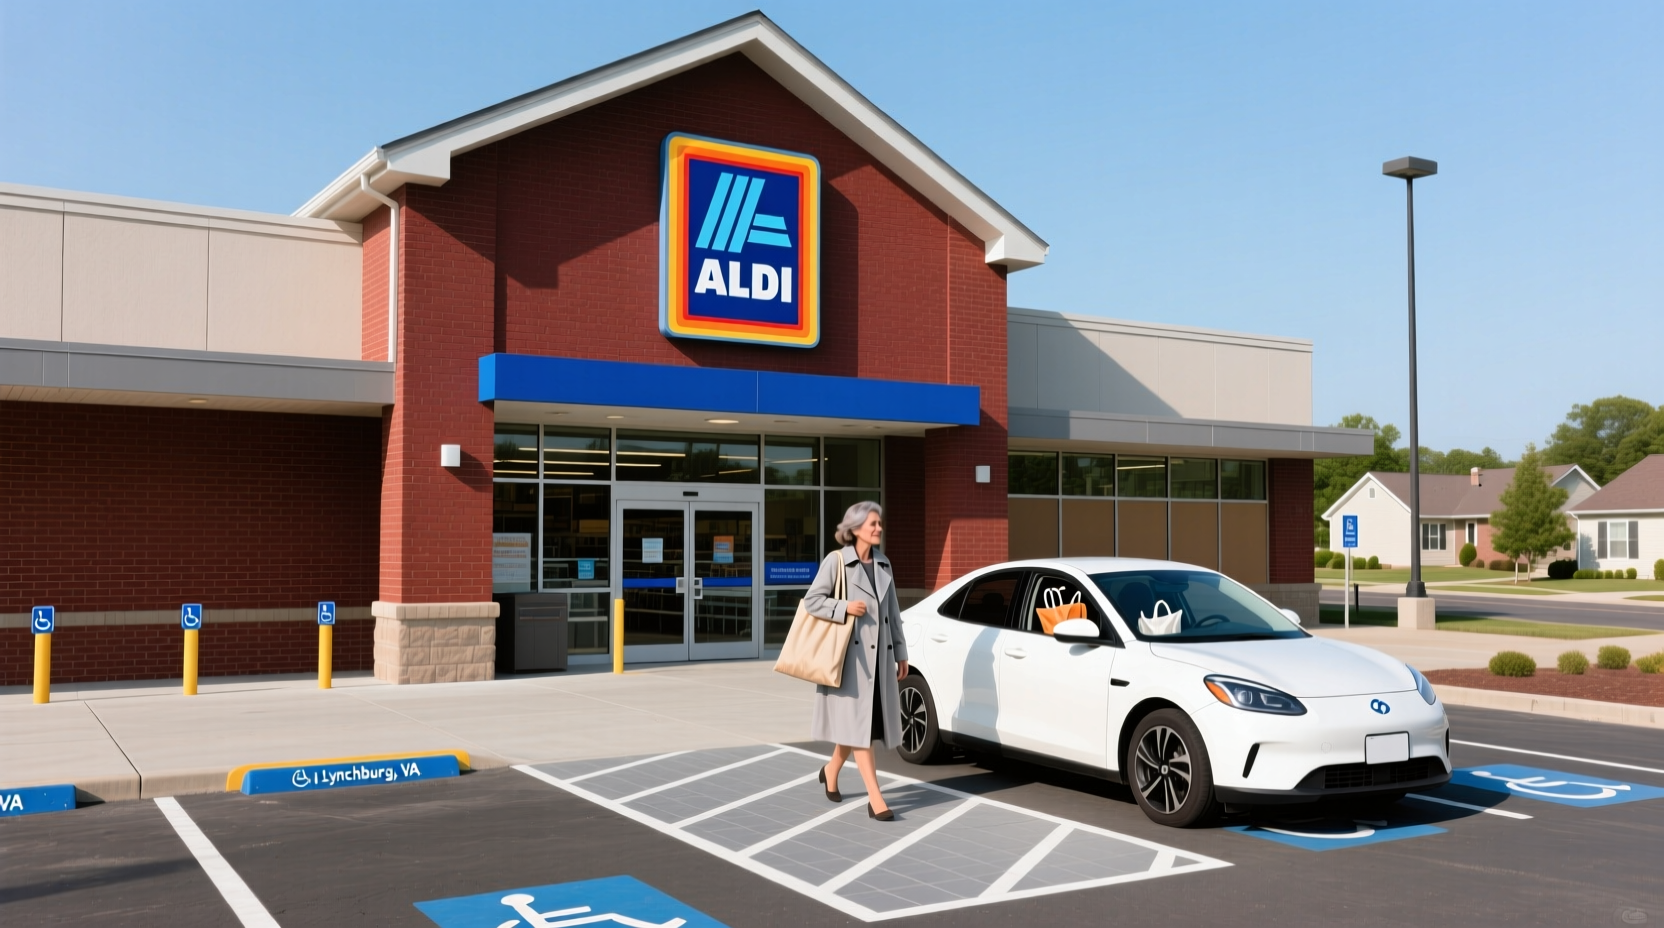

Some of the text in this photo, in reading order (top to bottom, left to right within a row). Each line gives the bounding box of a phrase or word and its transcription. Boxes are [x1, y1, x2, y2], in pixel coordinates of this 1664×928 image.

[694, 258, 792, 303] ALDI
[400, 762, 421, 777] VA
[0, 794, 24, 811] VA
